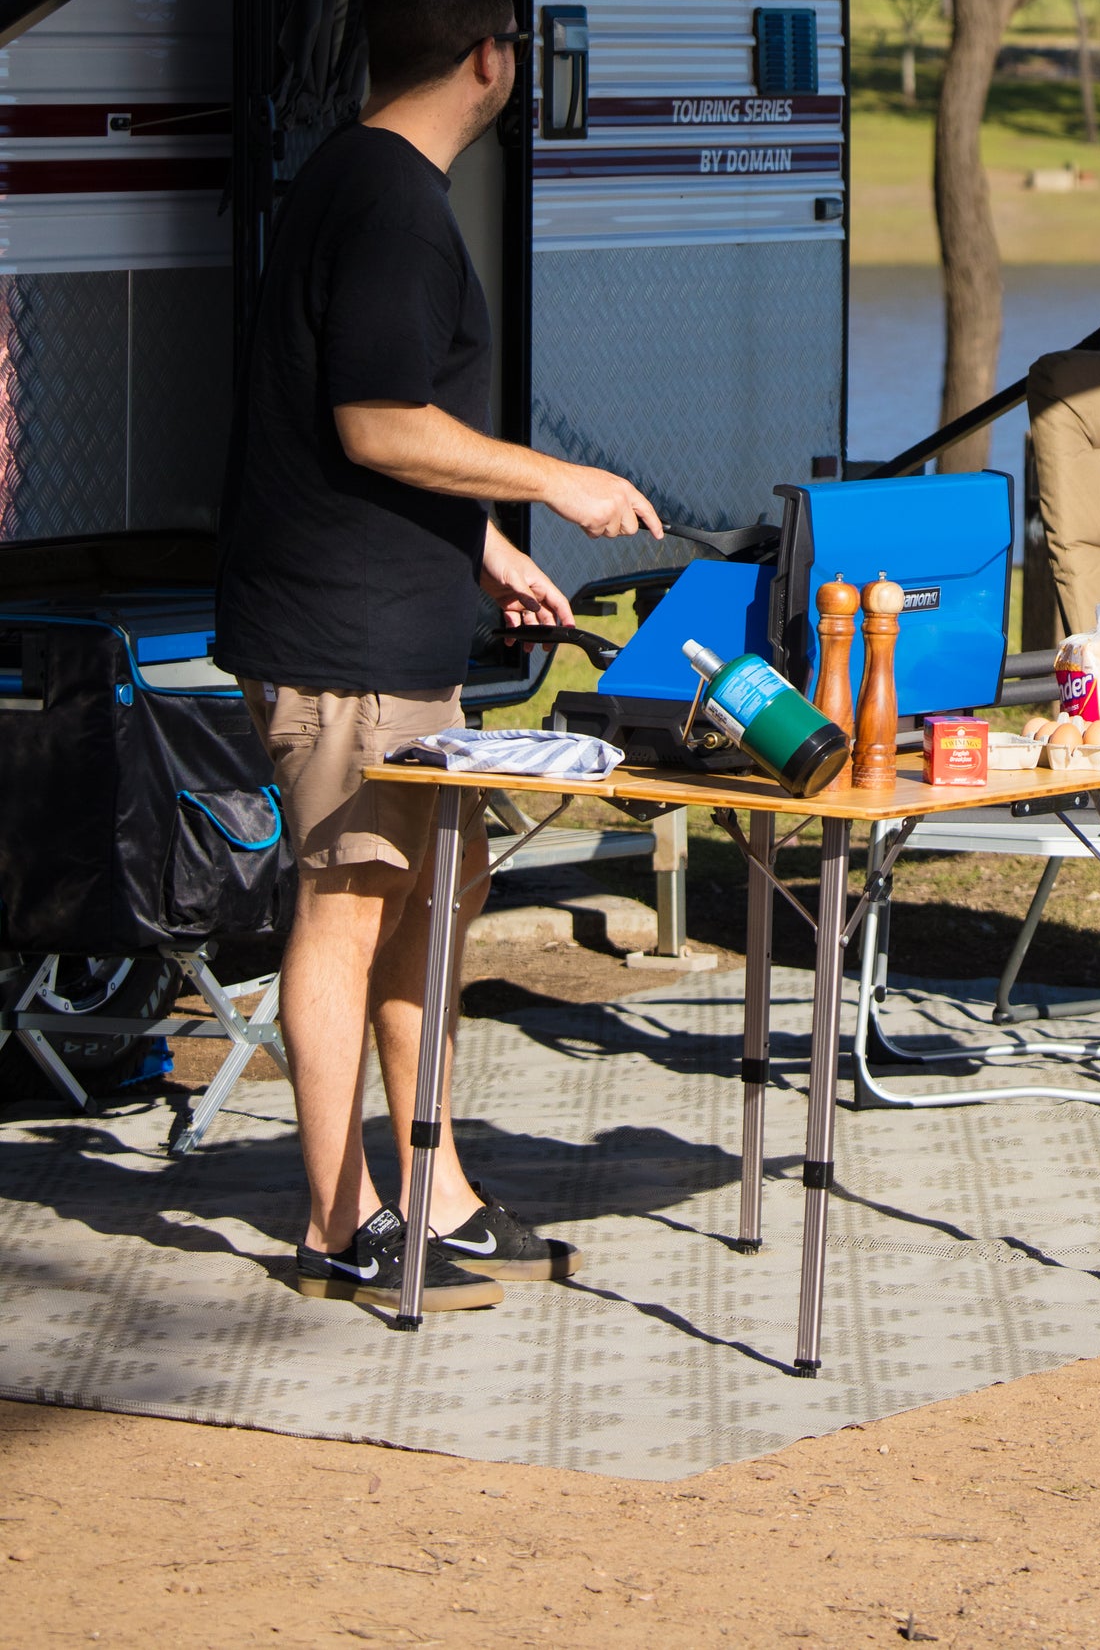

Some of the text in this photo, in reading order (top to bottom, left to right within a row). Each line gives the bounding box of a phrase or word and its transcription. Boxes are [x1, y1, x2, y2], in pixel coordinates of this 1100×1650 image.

[672, 99, 793, 123] TOURING SERIES
[700, 149, 792, 173] BY DOMAIN
[944, 739, 979, 749] TWININGS
